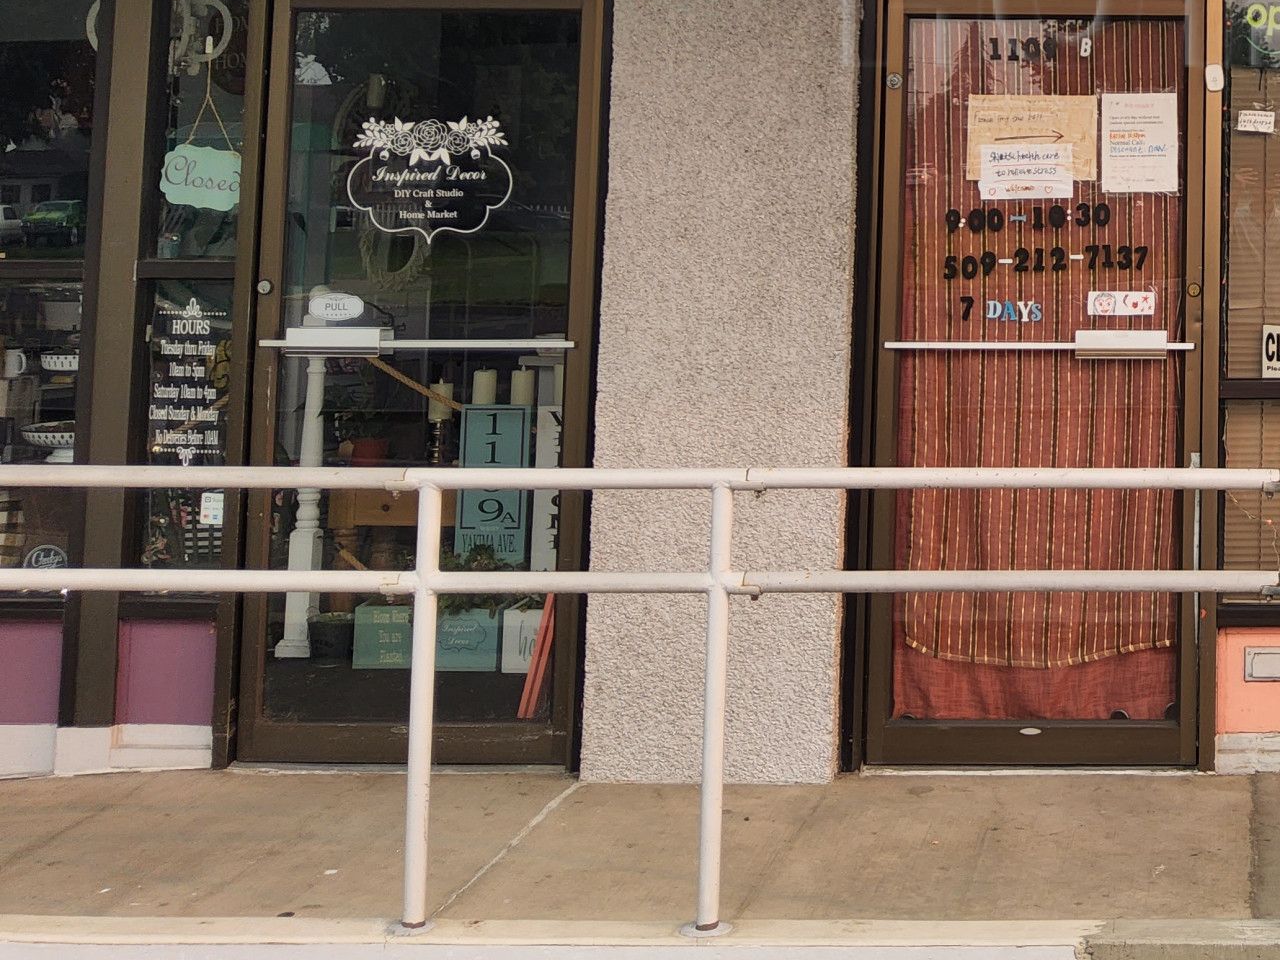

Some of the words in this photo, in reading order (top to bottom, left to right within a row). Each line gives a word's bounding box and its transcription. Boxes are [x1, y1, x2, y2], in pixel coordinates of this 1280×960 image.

[165, 155, 241, 192] Closed
[372, 166, 442, 186] Inspired
[445, 165, 488, 181] Decor
[995, 169, 1006, 177] to
[1033, 166, 1057, 175] stress
[394, 190, 411, 198] DIY
[412, 189, 434, 198] Craft
[435, 189, 464, 198] Studio
[424, 200, 433, 208] &
[399, 210, 425, 219] Home
[426, 210, 458, 219] Market
[325, 303, 348, 311] PULL
[959, 296, 975, 322] 7
[172, 319, 210, 335] HOURS
[160, 339, 184, 359] Tuesday
[197, 340, 217, 360] Friday
[153, 383, 180, 403] Saturday
[148, 404, 168, 420] Closed
[168, 405, 191, 425] Sunday
[196, 406, 220, 426] Monday
